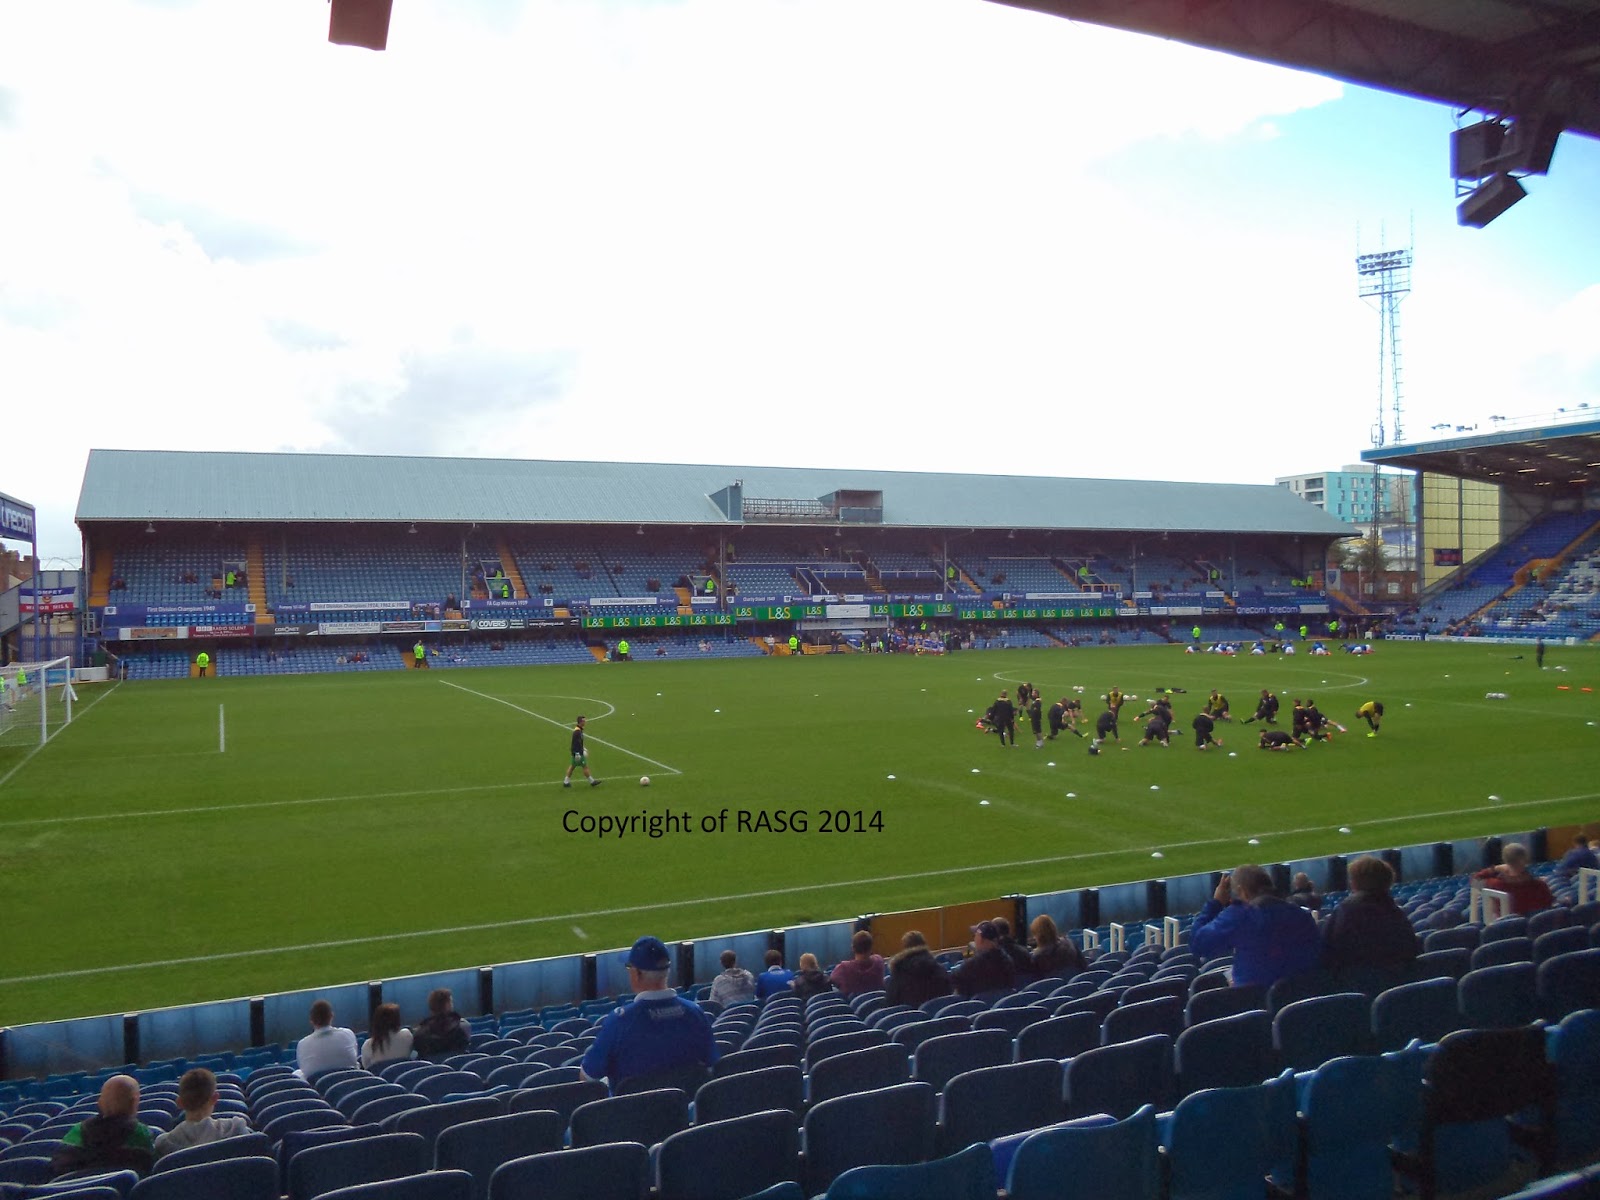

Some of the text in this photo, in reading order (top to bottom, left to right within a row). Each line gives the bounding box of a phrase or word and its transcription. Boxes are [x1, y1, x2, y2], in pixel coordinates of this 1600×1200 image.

[736, 607, 752, 616] L&S
[806, 606, 822, 615] L&S
[874, 605, 889, 614] L&S
[903, 604, 924, 616] L&S
[938, 604, 952, 612] L&S
[1080, 608, 1094, 617] L&S
[1099, 608, 1112, 617] L&S
[768, 607, 791, 619] L&S
[963, 611, 976, 619] L&S
[982, 610, 996, 618] L&S
[1003, 610, 1017, 618] L&S
[1023, 609, 1036, 618] L&S
[1042, 609, 1056, 617] L&S
[1061, 609, 1075, 617] L&S
[587, 618, 604, 627] L&S
[613, 618, 630, 627] L&S
[640, 617, 656, 626] L&S
[665, 616, 681, 625] L&S
[691, 615, 706, 625] L&S
[715, 615, 731, 624] L&S
